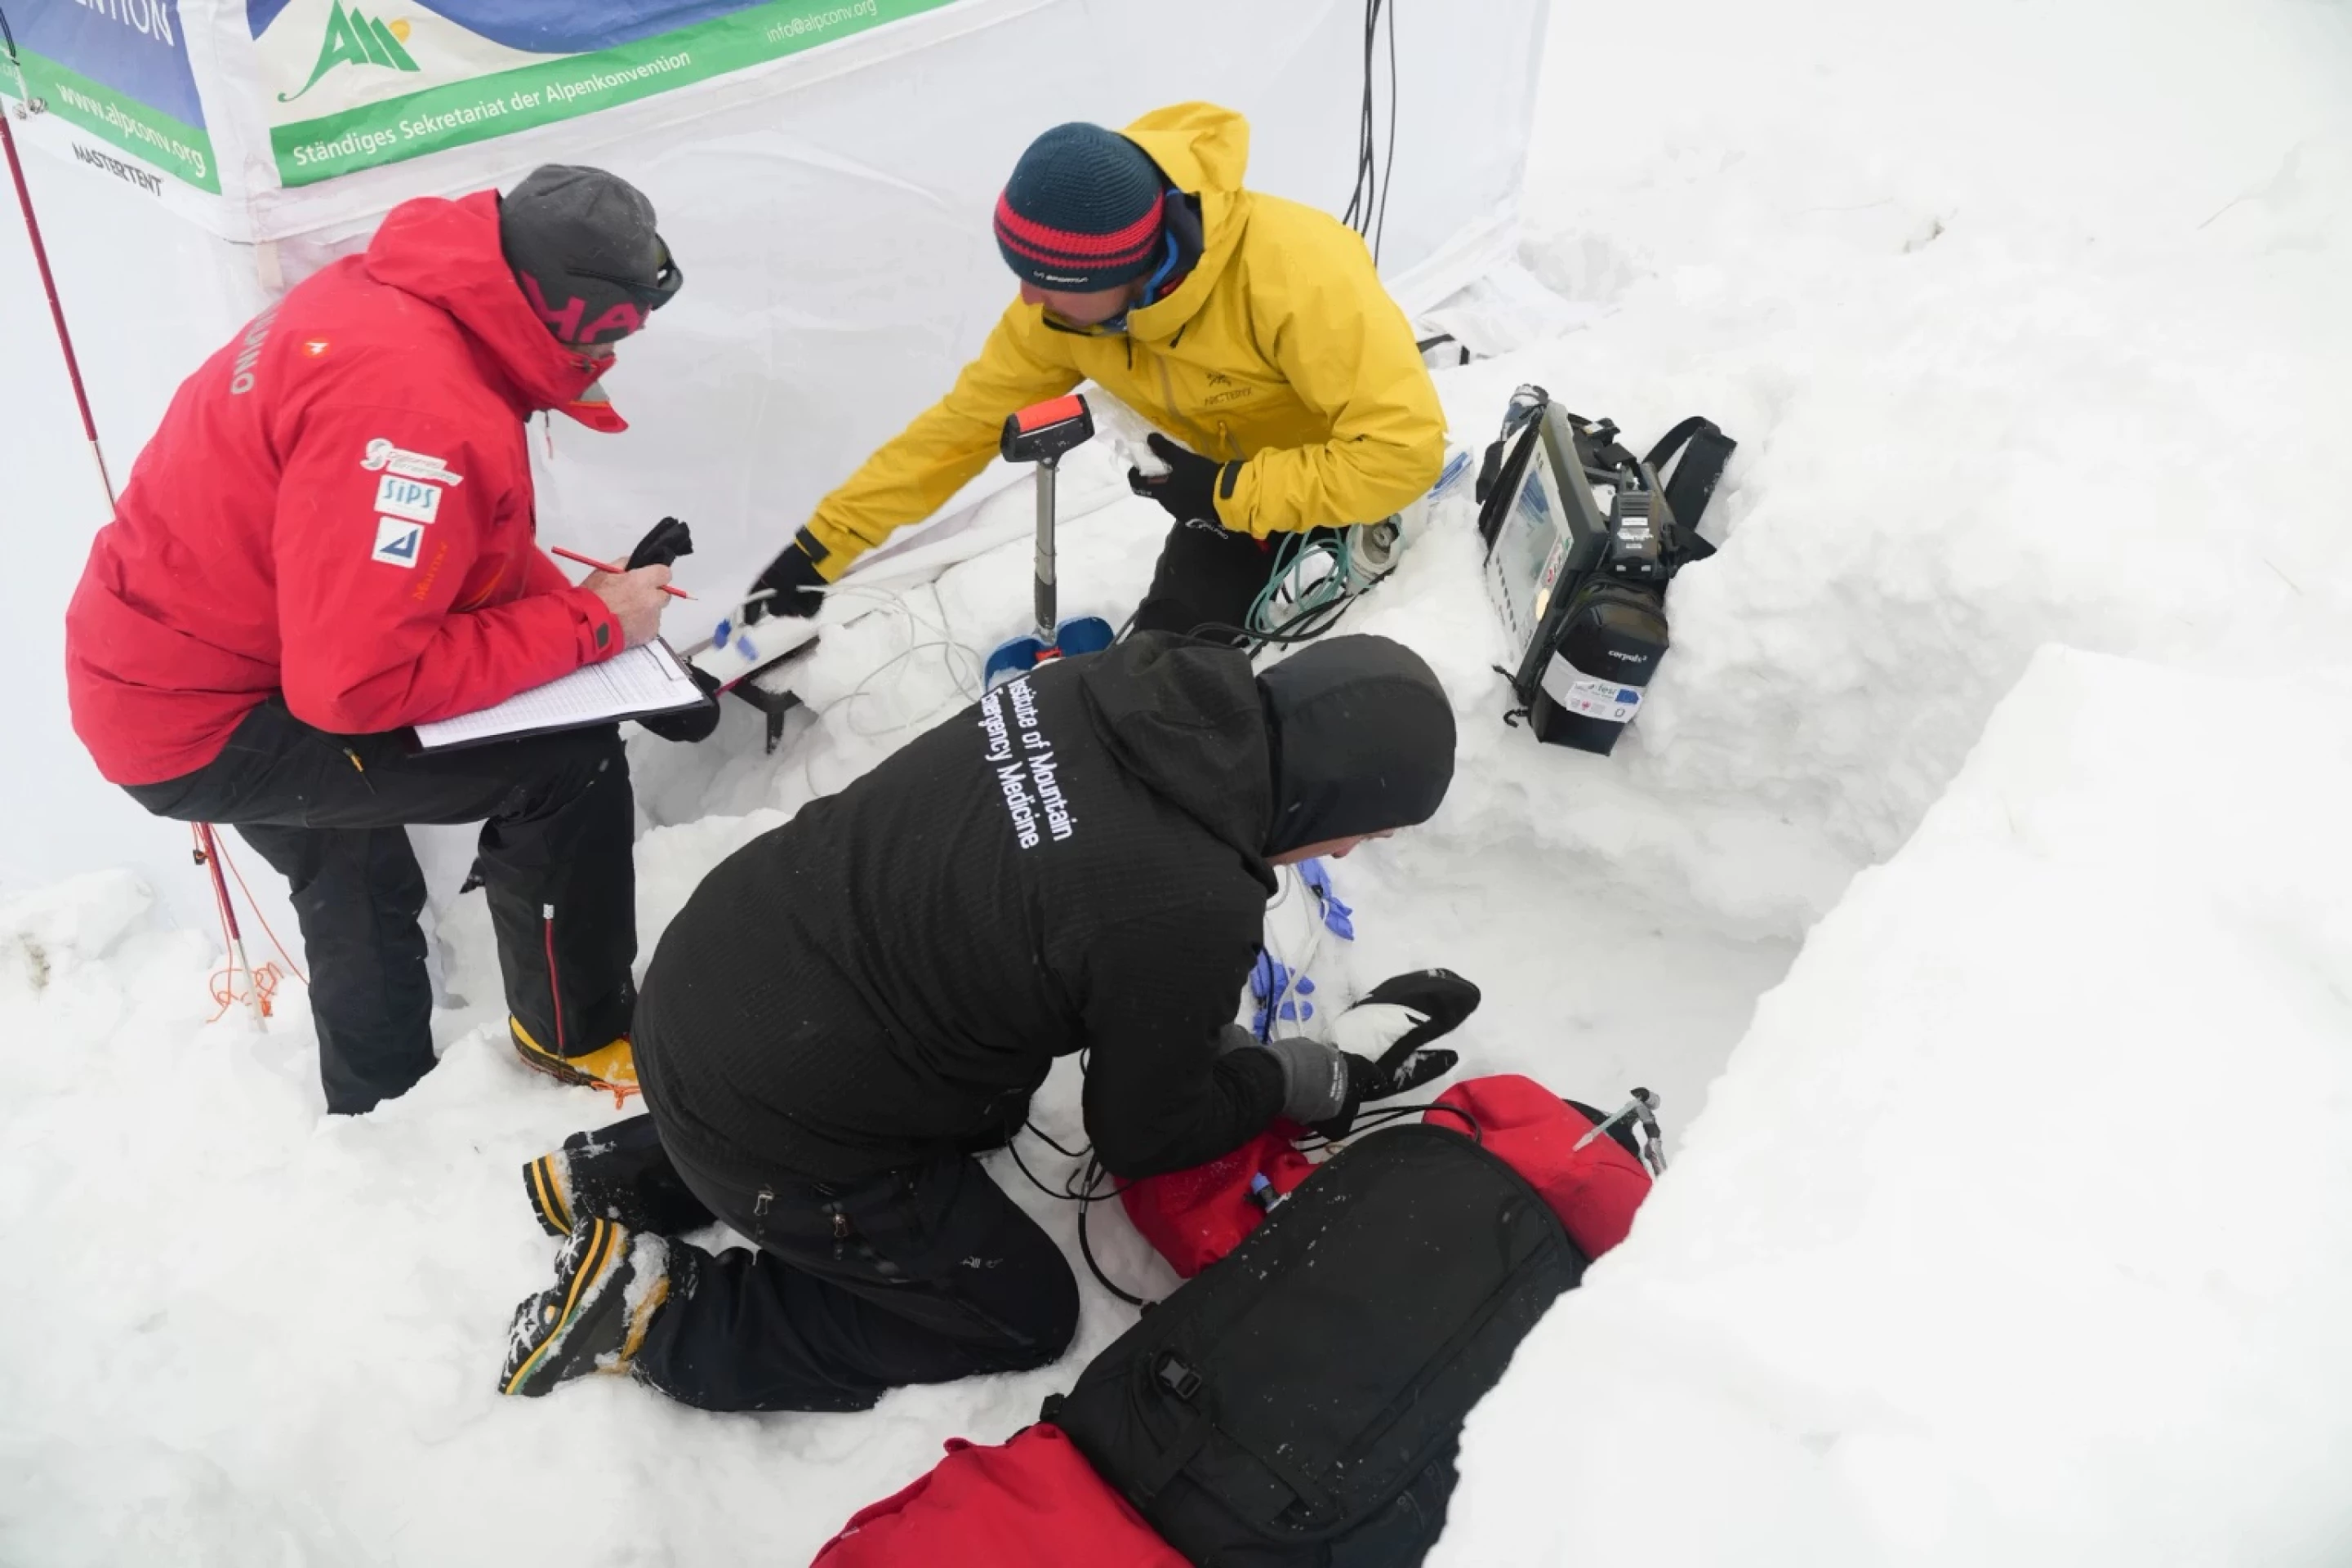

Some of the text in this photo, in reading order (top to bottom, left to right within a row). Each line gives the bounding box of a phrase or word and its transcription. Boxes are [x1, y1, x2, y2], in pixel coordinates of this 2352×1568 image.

[766, 0, 878, 43] info@alpconv.org
[56, 82, 207, 179] www.alpconv.org
[293, 50, 692, 167] Ständiges Sekretariat der Alpenkonvention
[72, 140, 164, 196] MASTERTENT
[996, 760, 1040, 850] Medicine
[1008, 675, 1079, 842] Institute of Mountain
